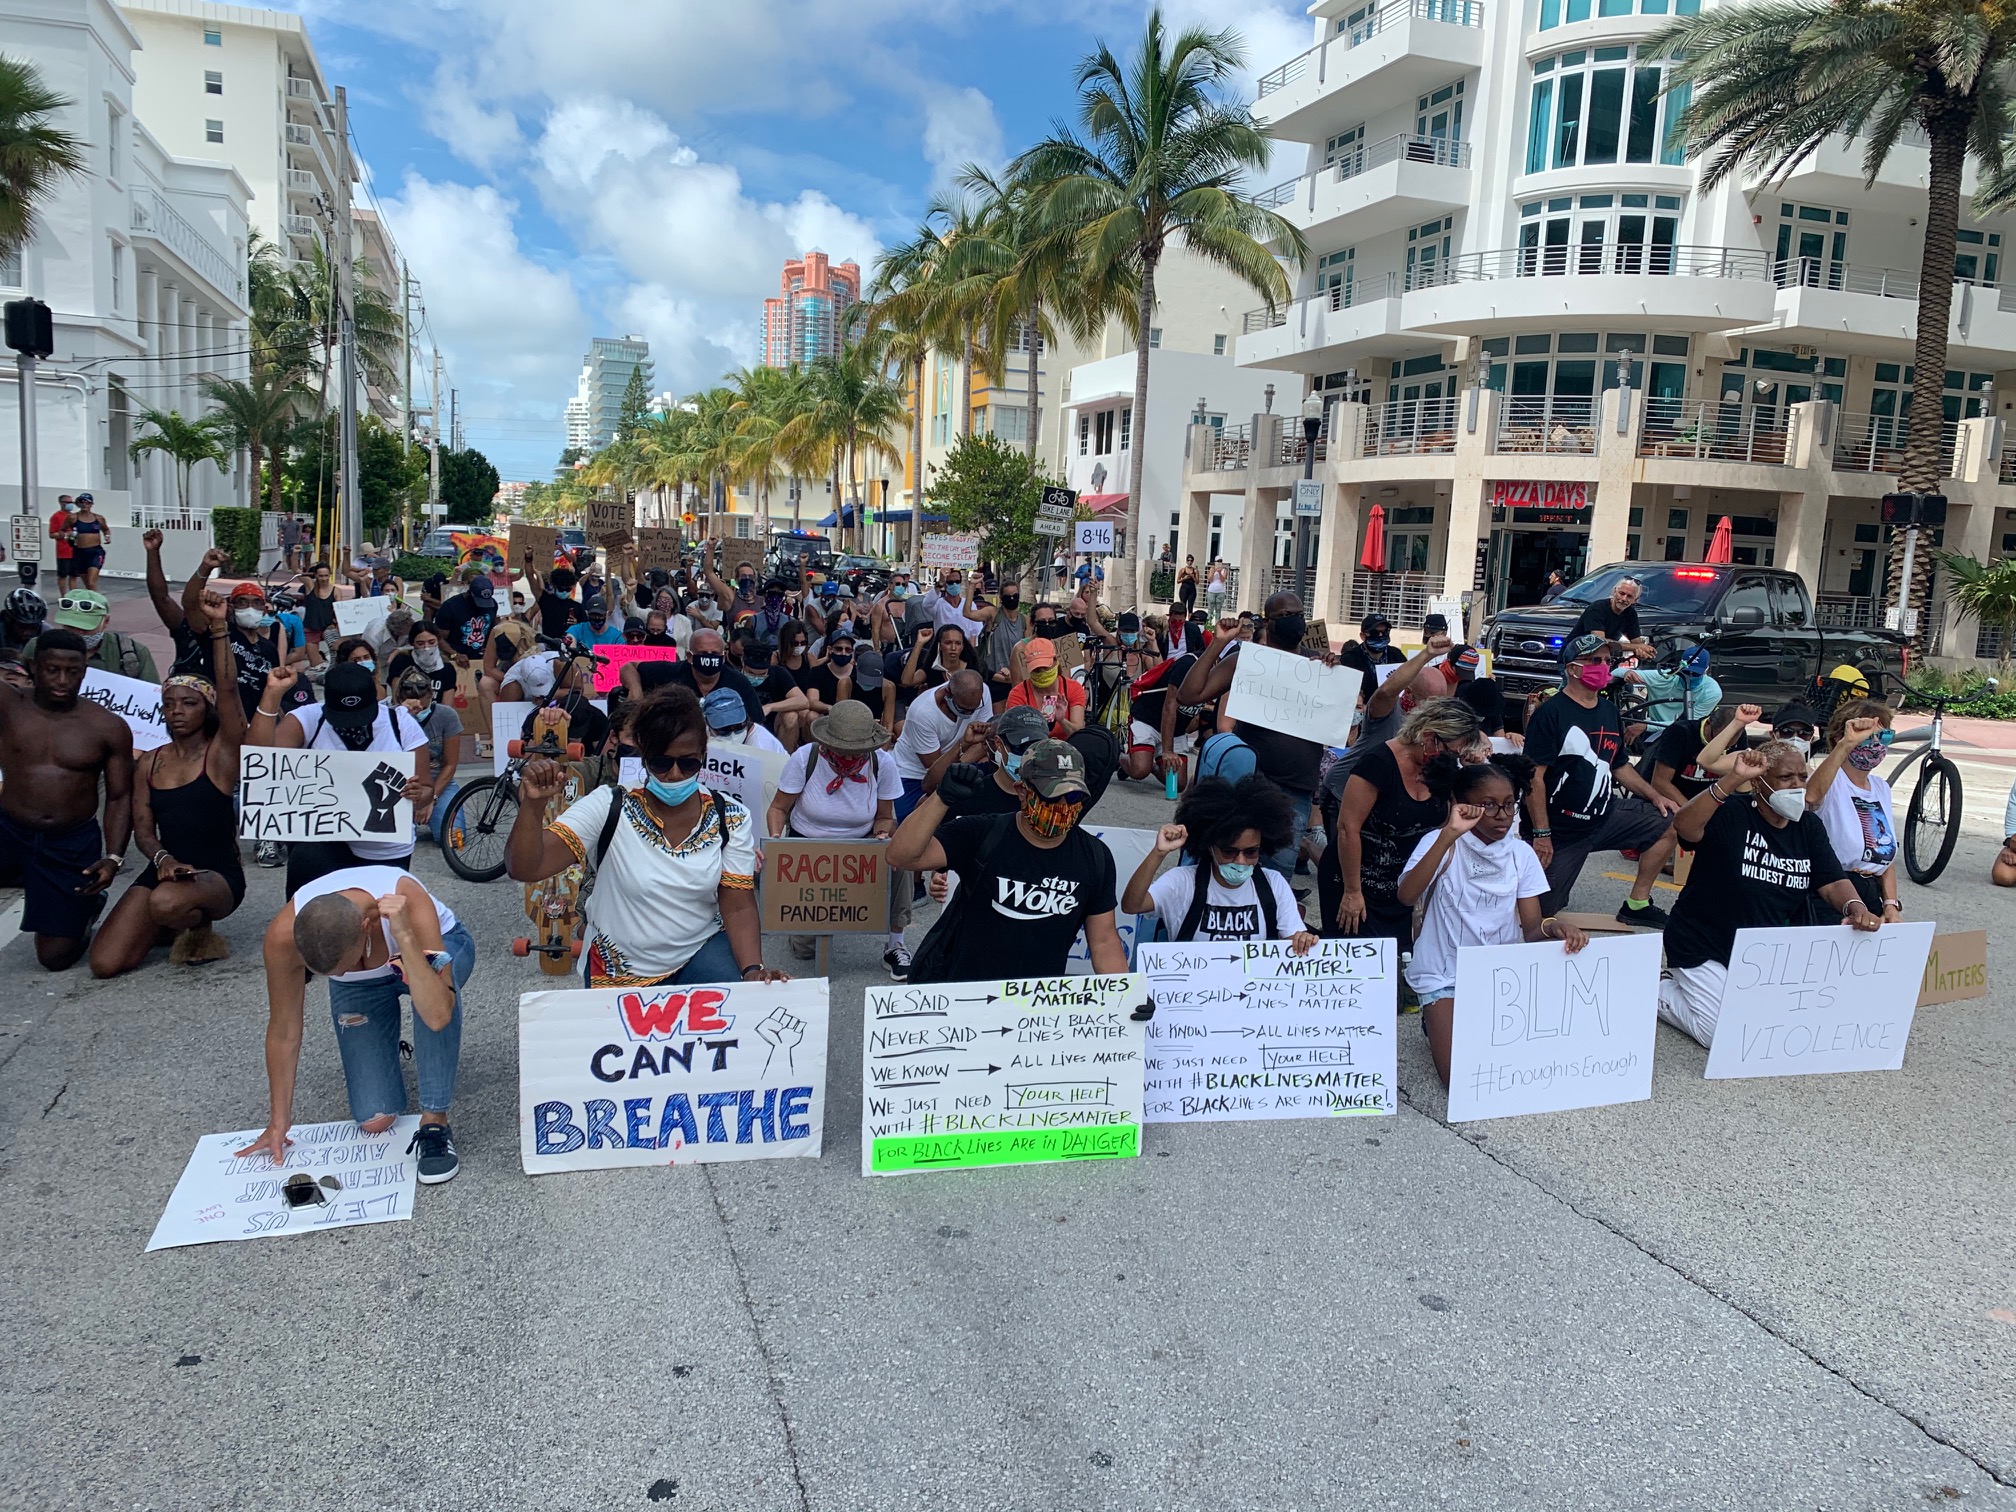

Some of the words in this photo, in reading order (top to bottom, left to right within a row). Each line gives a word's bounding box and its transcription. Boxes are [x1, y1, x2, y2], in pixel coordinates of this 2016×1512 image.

[1300, 487, 1319, 495] ONLY
[1493, 481, 1540, 507] PIZZA
[1544, 482, 1588, 509] DAYS
[591, 504, 626, 520] VOTE
[1042, 504, 1056, 514] BIKE
[1056, 507, 1072, 517] LANE
[589, 520, 626, 530] AGAINST
[1040, 523, 1061, 532] AHEAD
[924, 533, 948, 541] LIVES
[1082, 528, 1111, 545] 8:46
[923, 552, 950, 560] BECOME
[613, 647, 659, 660] EQUALITY
[1246, 649, 1334, 689] STOP
[1235, 677, 1326, 709] KILLING
[1263, 703, 1314, 728] US!!!
[703, 752, 746, 779] lack
[1057, 754, 1073, 770] M
[242, 782, 339, 809] LIVES
[239, 808, 362, 839] MATTER
[1751, 834, 1768, 850] AM
[1743, 846, 1758, 863] MY
[776, 853, 878, 884] RACISM
[1741, 863, 1785, 885] WILDEST
[799, 887, 815, 902] IS
[820, 887, 848, 902] THE
[996, 876, 1079, 916] Woke
[1040, 876, 1081, 896] stay
[780, 905, 869, 922] PANDEMIC
[1206, 910, 1255, 932] BLACK
[1141, 950, 1167, 972] WE
[1172, 951, 1208, 972] SAID
[1246, 943, 1310, 960] BLAC
[1322, 940, 1378, 959] LIVES
[1737, 936, 1897, 990] SILENCE
[1275, 959, 1353, 978] MATTER!
[870, 991, 899, 1015] WE
[903, 989, 950, 1014] SAID
[1004, 981, 1072, 997] BLACK
[1082, 977, 1130, 992] LIVES
[1031, 992, 1106, 1008] MATTER!
[1244, 981, 1295, 998] ONLY
[1304, 983, 1363, 998] BLACK
[1788, 985, 1838, 1012] IS
[1246, 998, 1288, 1010] LIVES
[1298, 998, 1362, 1010] MATTER
[1491, 956, 1610, 1047] BLM
[619, 987, 736, 1042] WE
[868, 1029, 931, 1052] NEVER
[936, 1026, 977, 1044] SAID
[1017, 1014, 1061, 1030] ONLY
[1068, 1013, 1121, 1027] BLACK
[1017, 1029, 1065, 1043] LIVES
[1072, 1026, 1129, 1040] MATTER
[1169, 1023, 1208, 1038] KNOW
[1256, 1025, 1282, 1038] ALL
[1325, 1024, 1382, 1037] MATTER
[1740, 1022, 1896, 1063] VIOLENCE
[590, 1037, 739, 1083] CAN'T
[870, 1065, 898, 1081] WE
[902, 1063, 950, 1079] KNOW
[1010, 1054, 1044, 1067] ALL
[1092, 1050, 1142, 1064] MATTER
[1144, 1057, 1166, 1071] WE
[1172, 1057, 1205, 1069] JUST
[1211, 1056, 1248, 1066] NEED
[1308, 1050, 1350, 1063] HELP
[1143, 1076, 1182, 1092] WITH
[1189, 1071, 1386, 1091] #BLACKLIVESMATTER
[869, 1096, 894, 1117] WE
[900, 1096, 940, 1115] JUST
[954, 1094, 992, 1109] NEED
[1011, 1087, 1065, 1107] YOUR
[1070, 1086, 1106, 1103] HELP
[1143, 1101, 1175, 1117] FOR
[1275, 1095, 1301, 1109] ARE
[533, 1086, 814, 1156] BREATHE
[869, 1116, 915, 1138] WITH
[877, 1145, 908, 1164] FOR
[1010, 1134, 1036, 1151] ARE
[1061, 1128, 1137, 1153] DANGER!
[218, 1142, 390, 1176] ANCESTRAL
[337, 1162, 406, 1189] HEA
[193, 1211, 226, 1225] ONE
[195, 1203, 223, 1216] LOVE
[312, 1191, 399, 1225] LET
[243, 1210, 290, 1235] US
